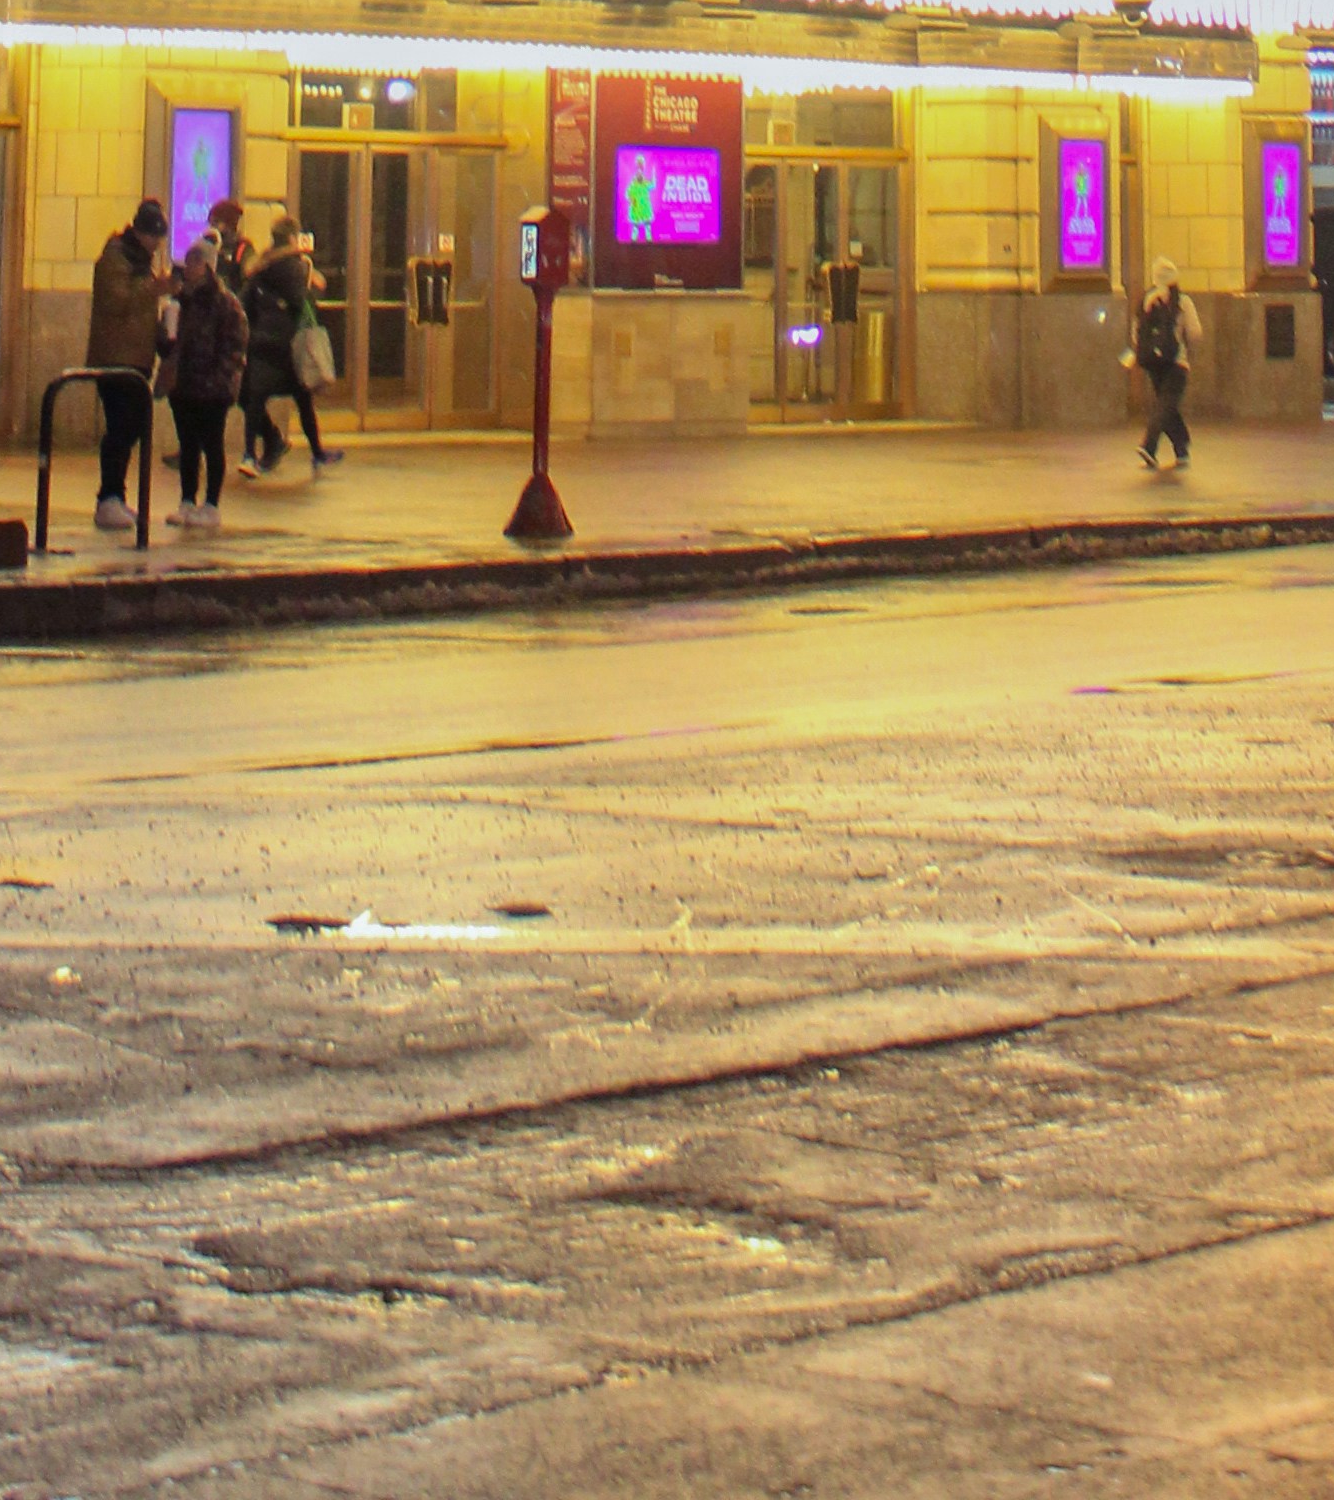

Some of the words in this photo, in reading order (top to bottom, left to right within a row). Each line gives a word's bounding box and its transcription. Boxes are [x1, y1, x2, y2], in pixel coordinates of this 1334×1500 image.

[653, 95, 699, 109] CHICAGO
[653, 108, 699, 123] THEATRE
[664, 174, 709, 191] DEAD
